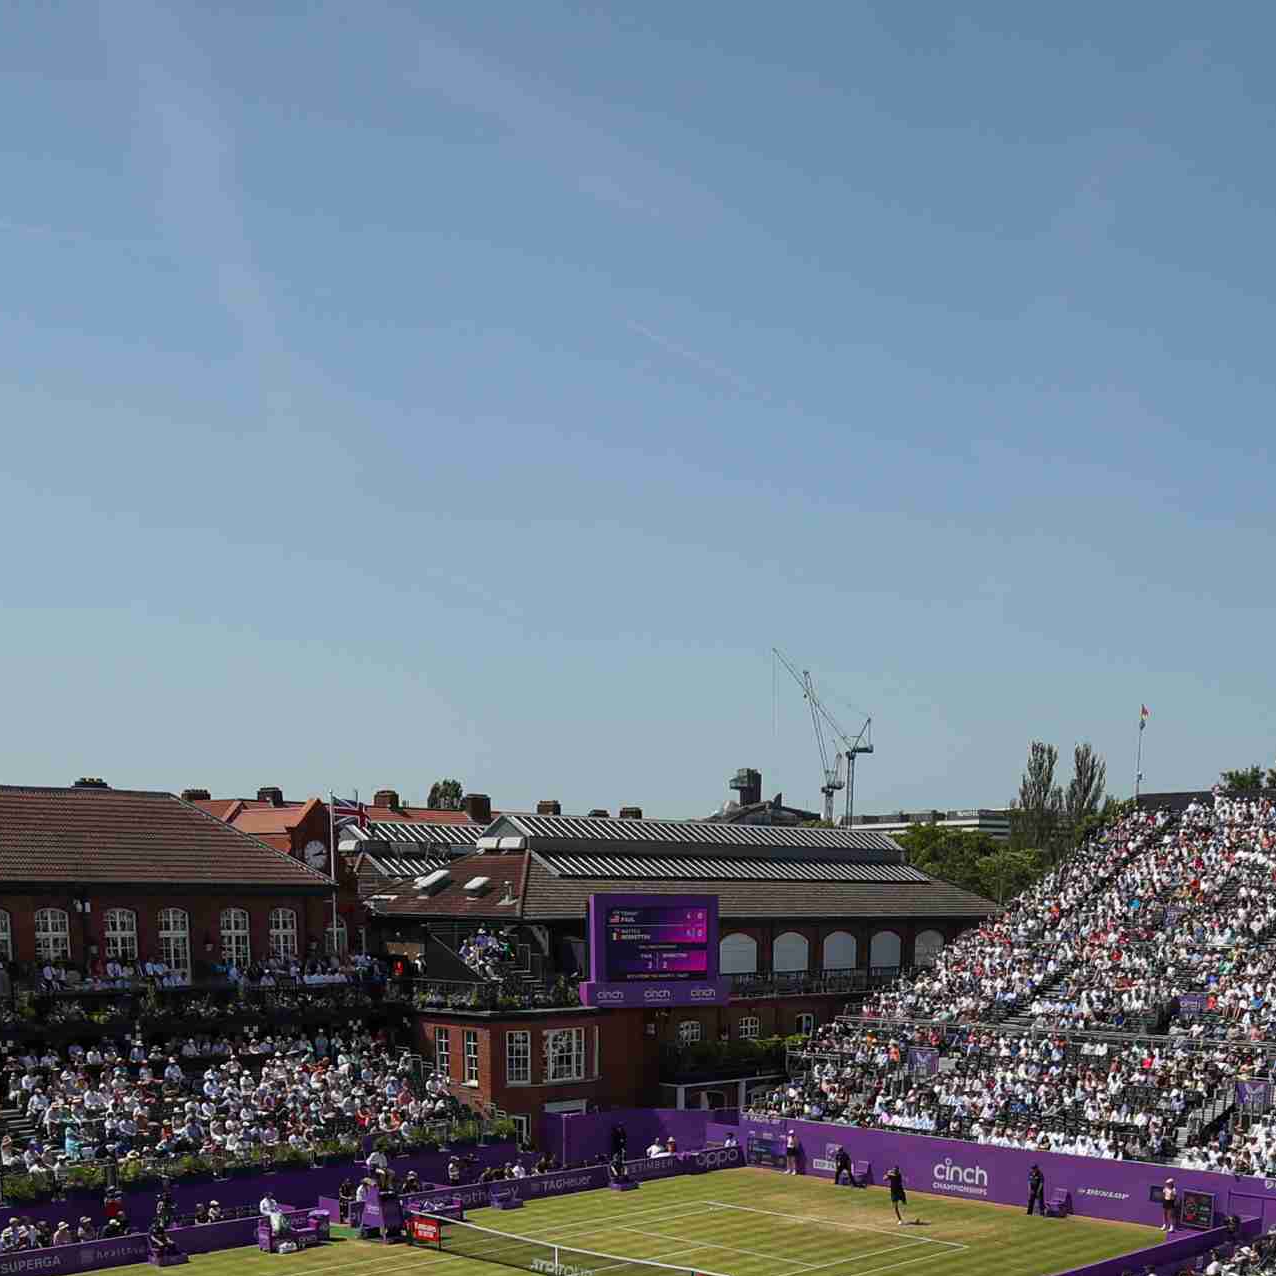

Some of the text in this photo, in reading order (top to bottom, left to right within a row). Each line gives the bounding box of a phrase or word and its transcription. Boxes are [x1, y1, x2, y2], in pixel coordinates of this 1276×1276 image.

[696, 1148, 739, 1168] oppo
[933, 1157, 988, 1187] cinch
[0, 1255, 61, 1275] SUPERGA
